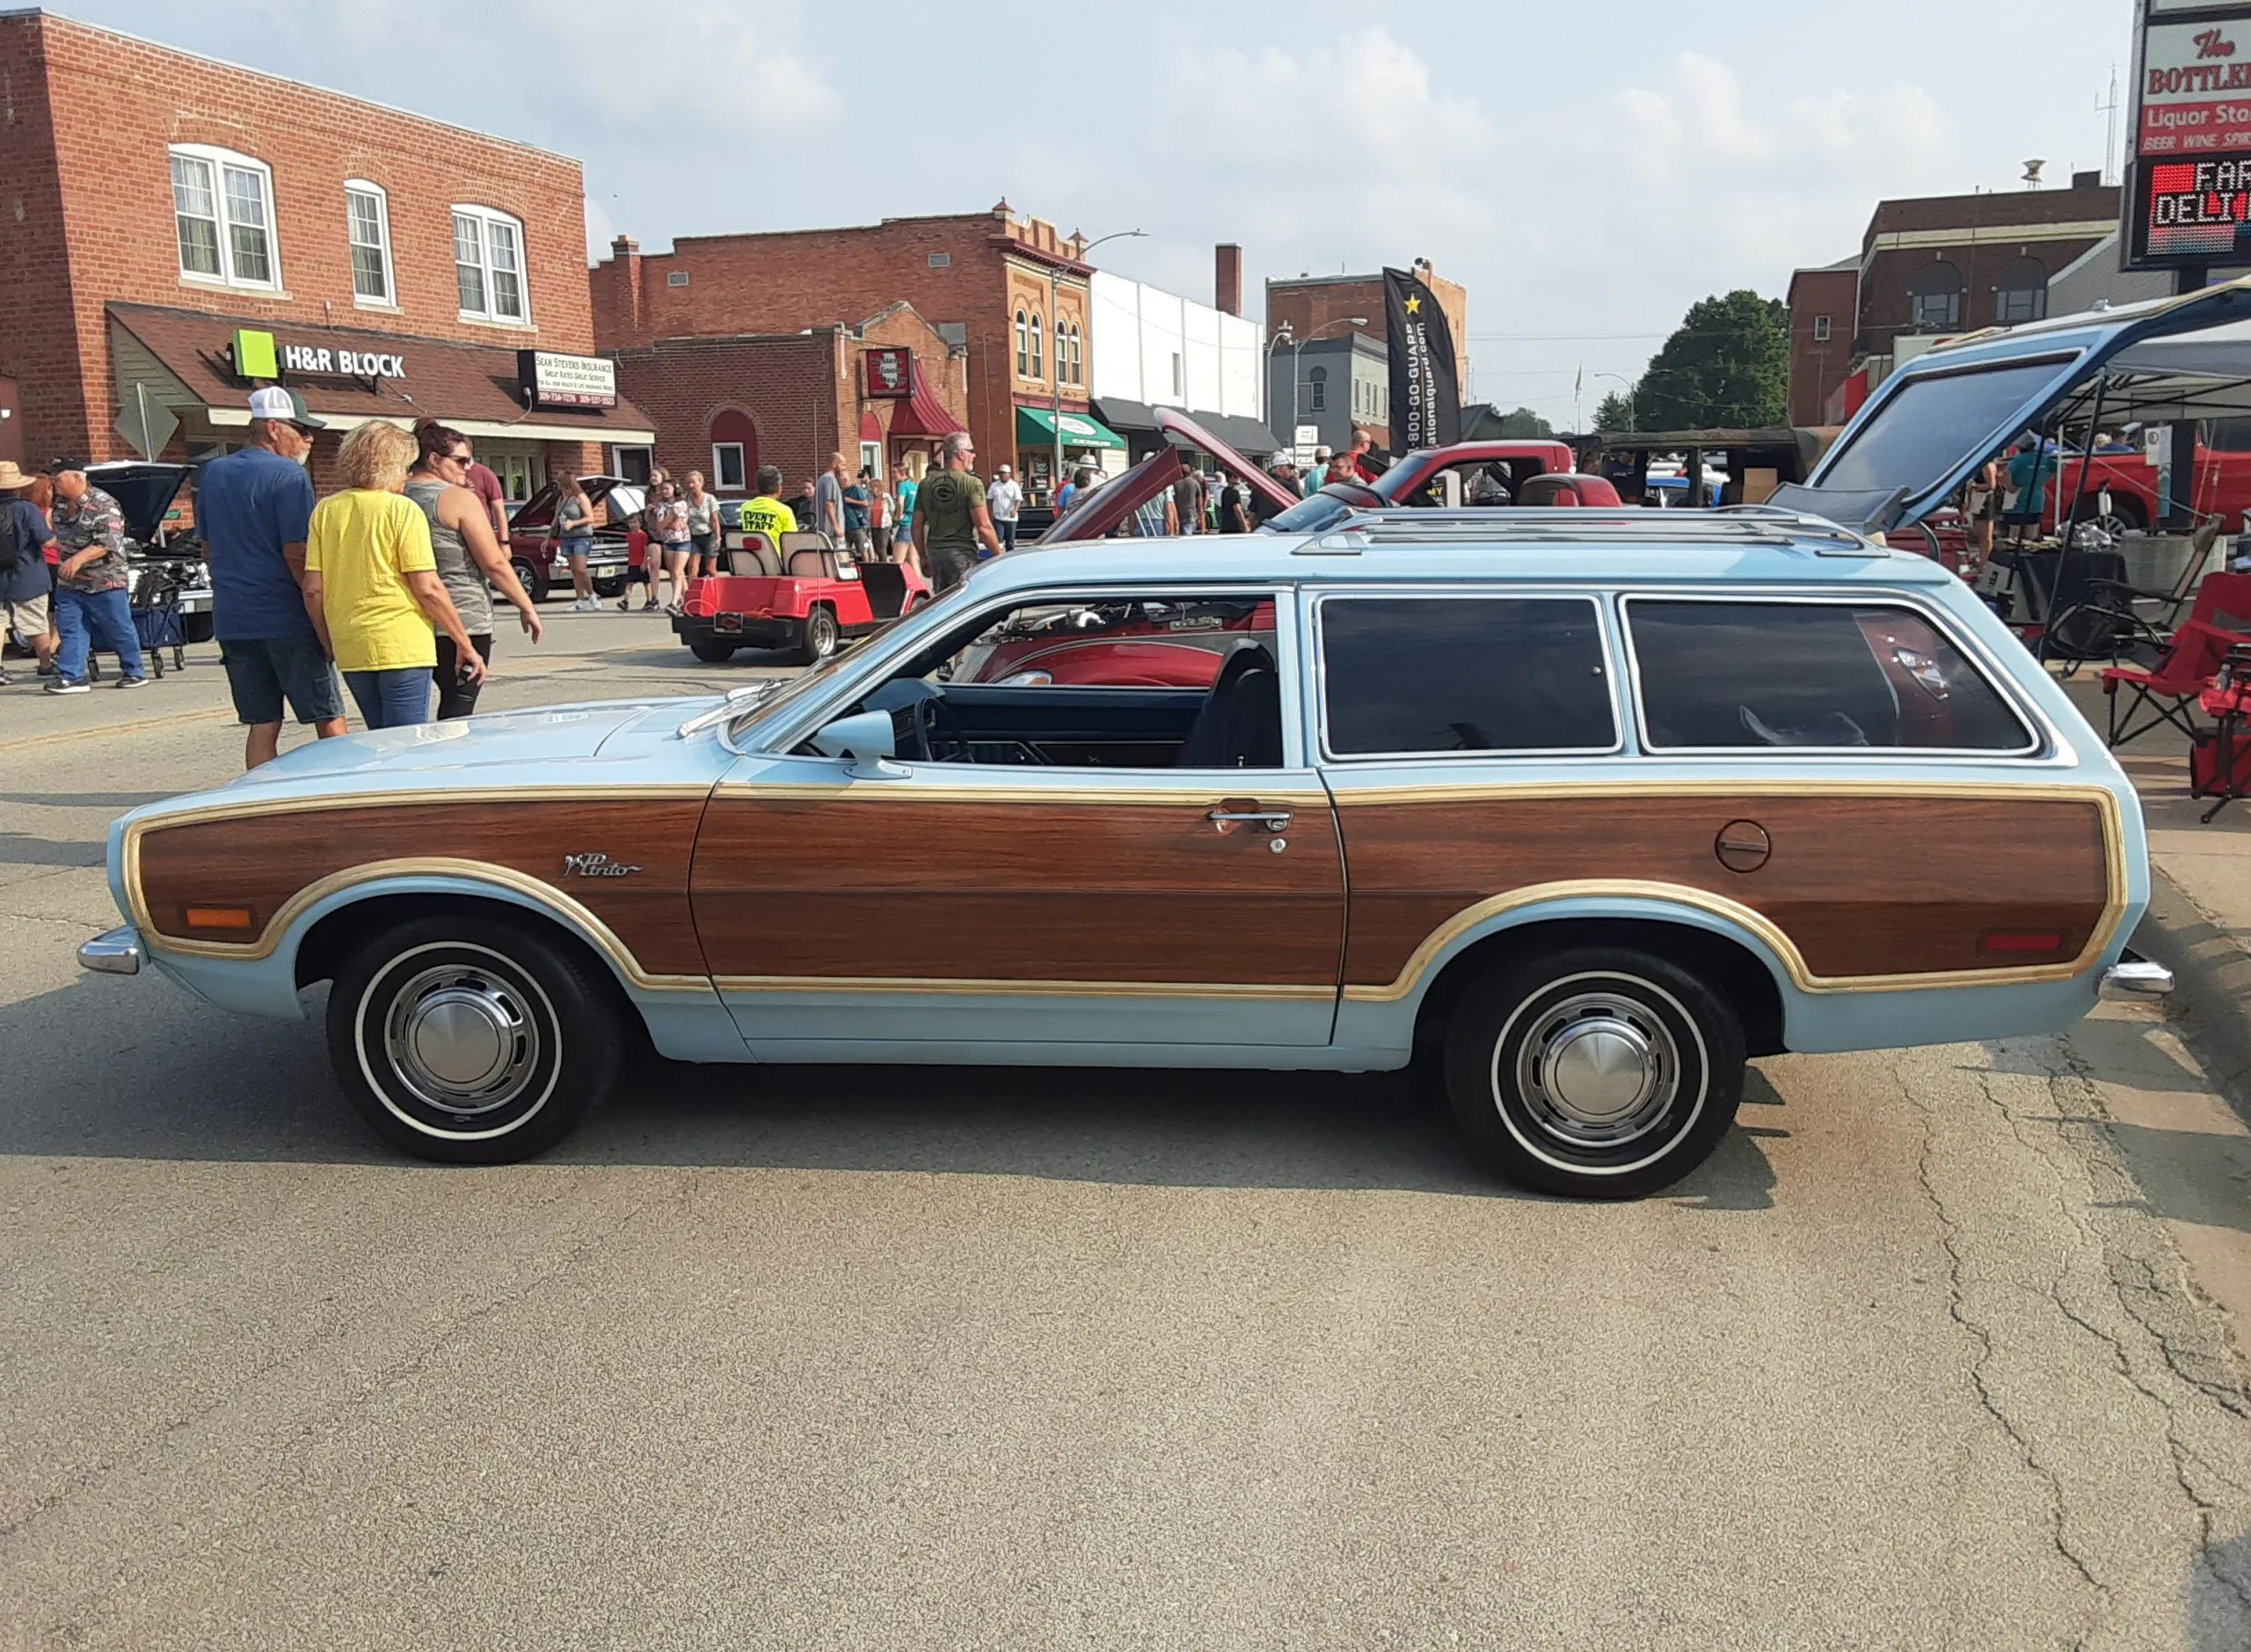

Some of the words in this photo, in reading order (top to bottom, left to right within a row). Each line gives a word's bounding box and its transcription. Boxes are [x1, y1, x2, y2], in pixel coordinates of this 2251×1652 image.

[2147, 62, 2251, 95] BOTTLE
[2147, 106, 2210, 130] Liquor
[2215, 104, 2251, 124] Sto
[2182, 133, 2218, 148] WINE
[2155, 192, 2234, 224] DELI
[285, 345, 333, 372] H&R
[339, 350, 406, 378] BLOCK
[554, 357, 579, 370] STEVENS
[581, 360, 613, 374] INSURANCE
[1416, 322, 1437, 448] ationalguard.com
[744, 511, 776, 523] EVENT
[744, 520, 775, 530] STAFF
[579, 853, 643, 877] Pinto
